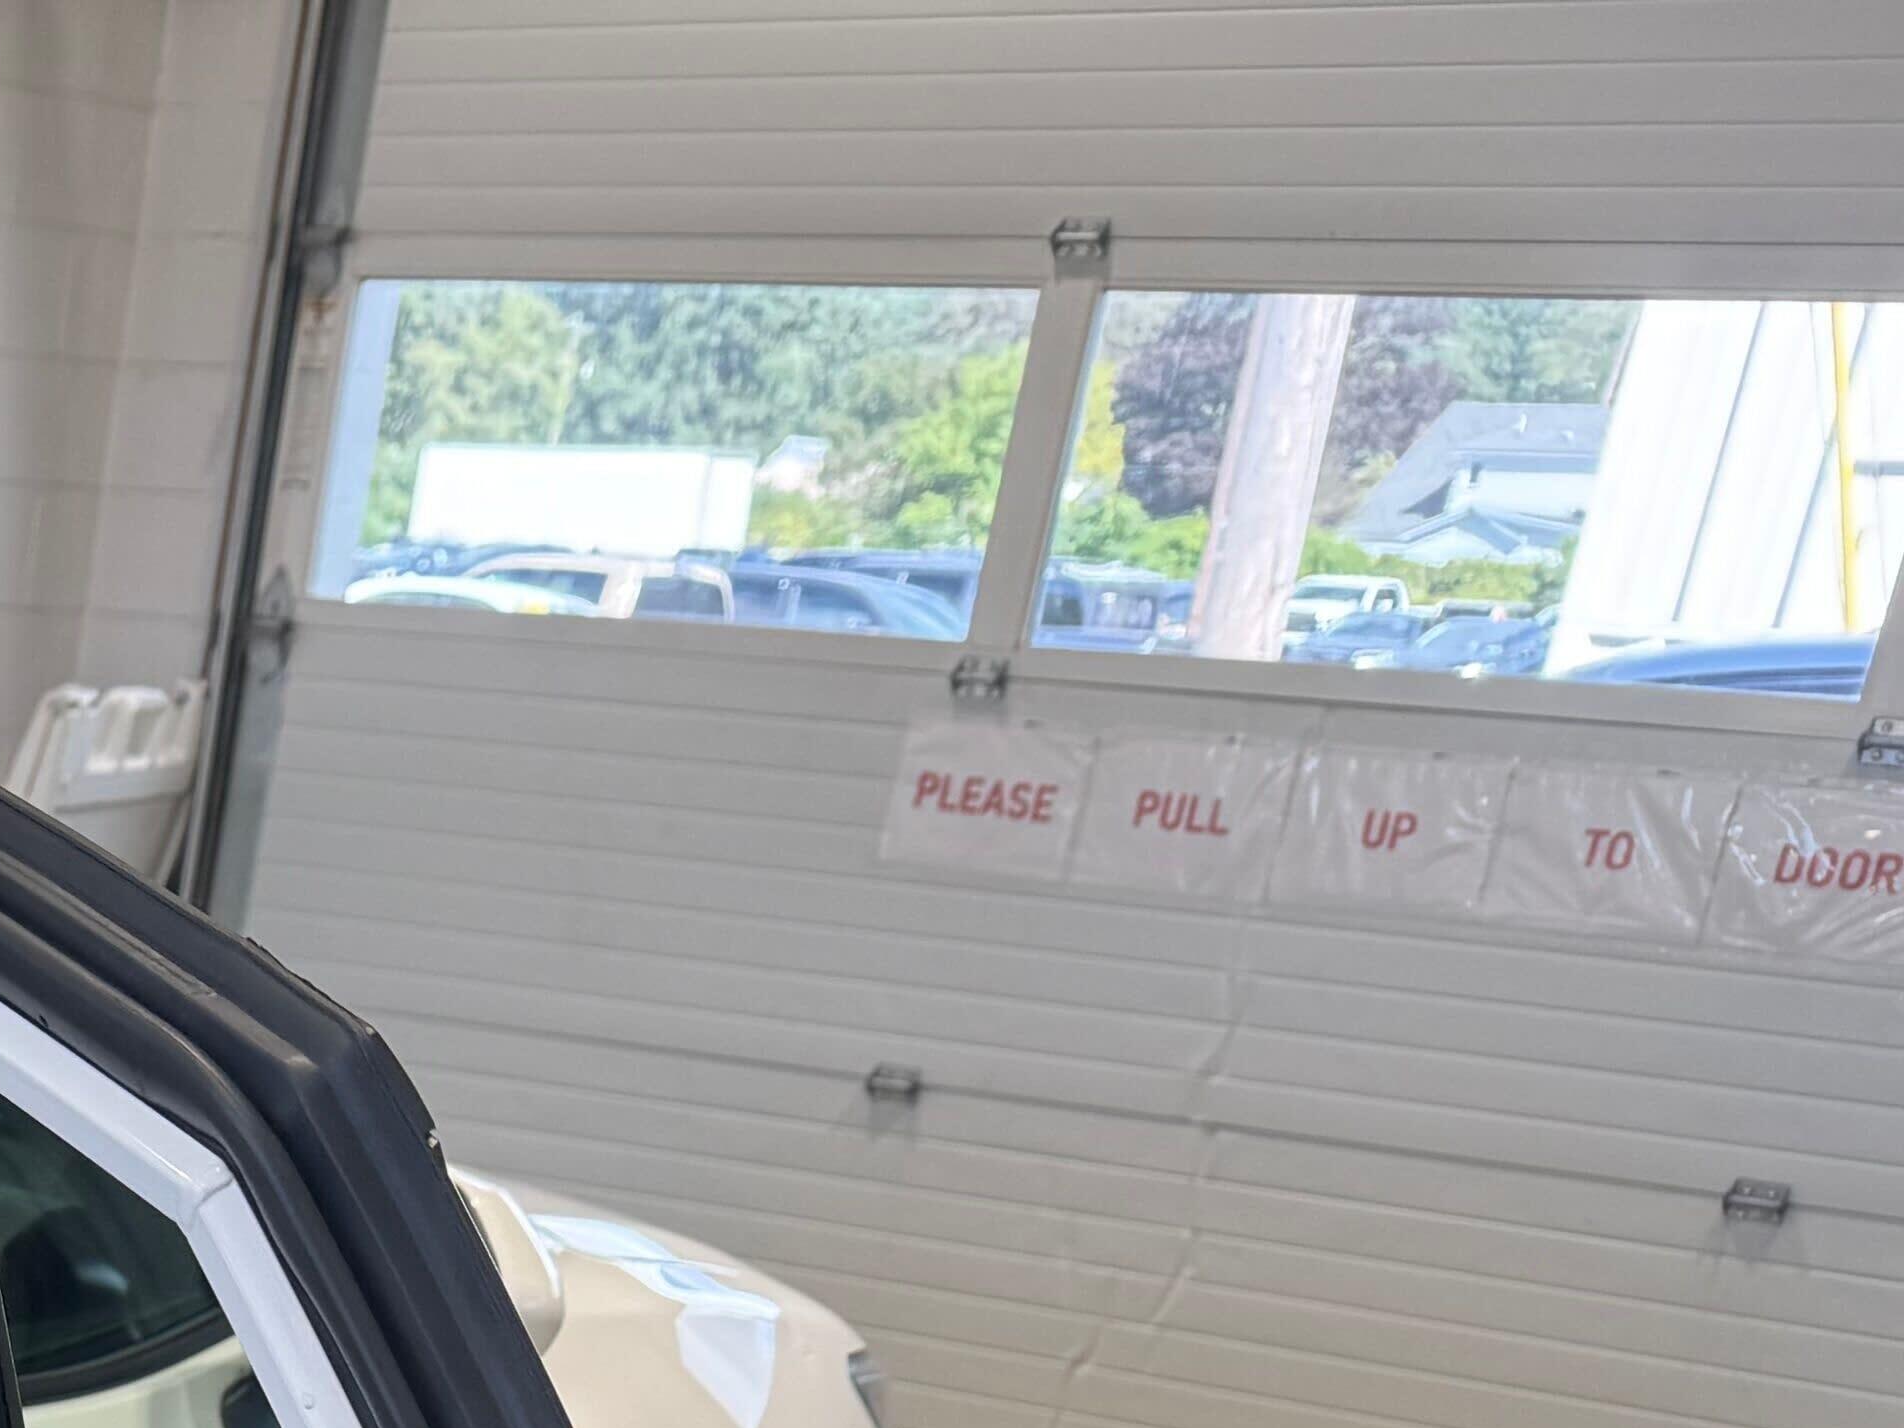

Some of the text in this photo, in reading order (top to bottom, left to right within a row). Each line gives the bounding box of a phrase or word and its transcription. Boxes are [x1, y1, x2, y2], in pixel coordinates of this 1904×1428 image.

[912, 769, 1904, 895] PLEASE PULL UP TO DOOR
